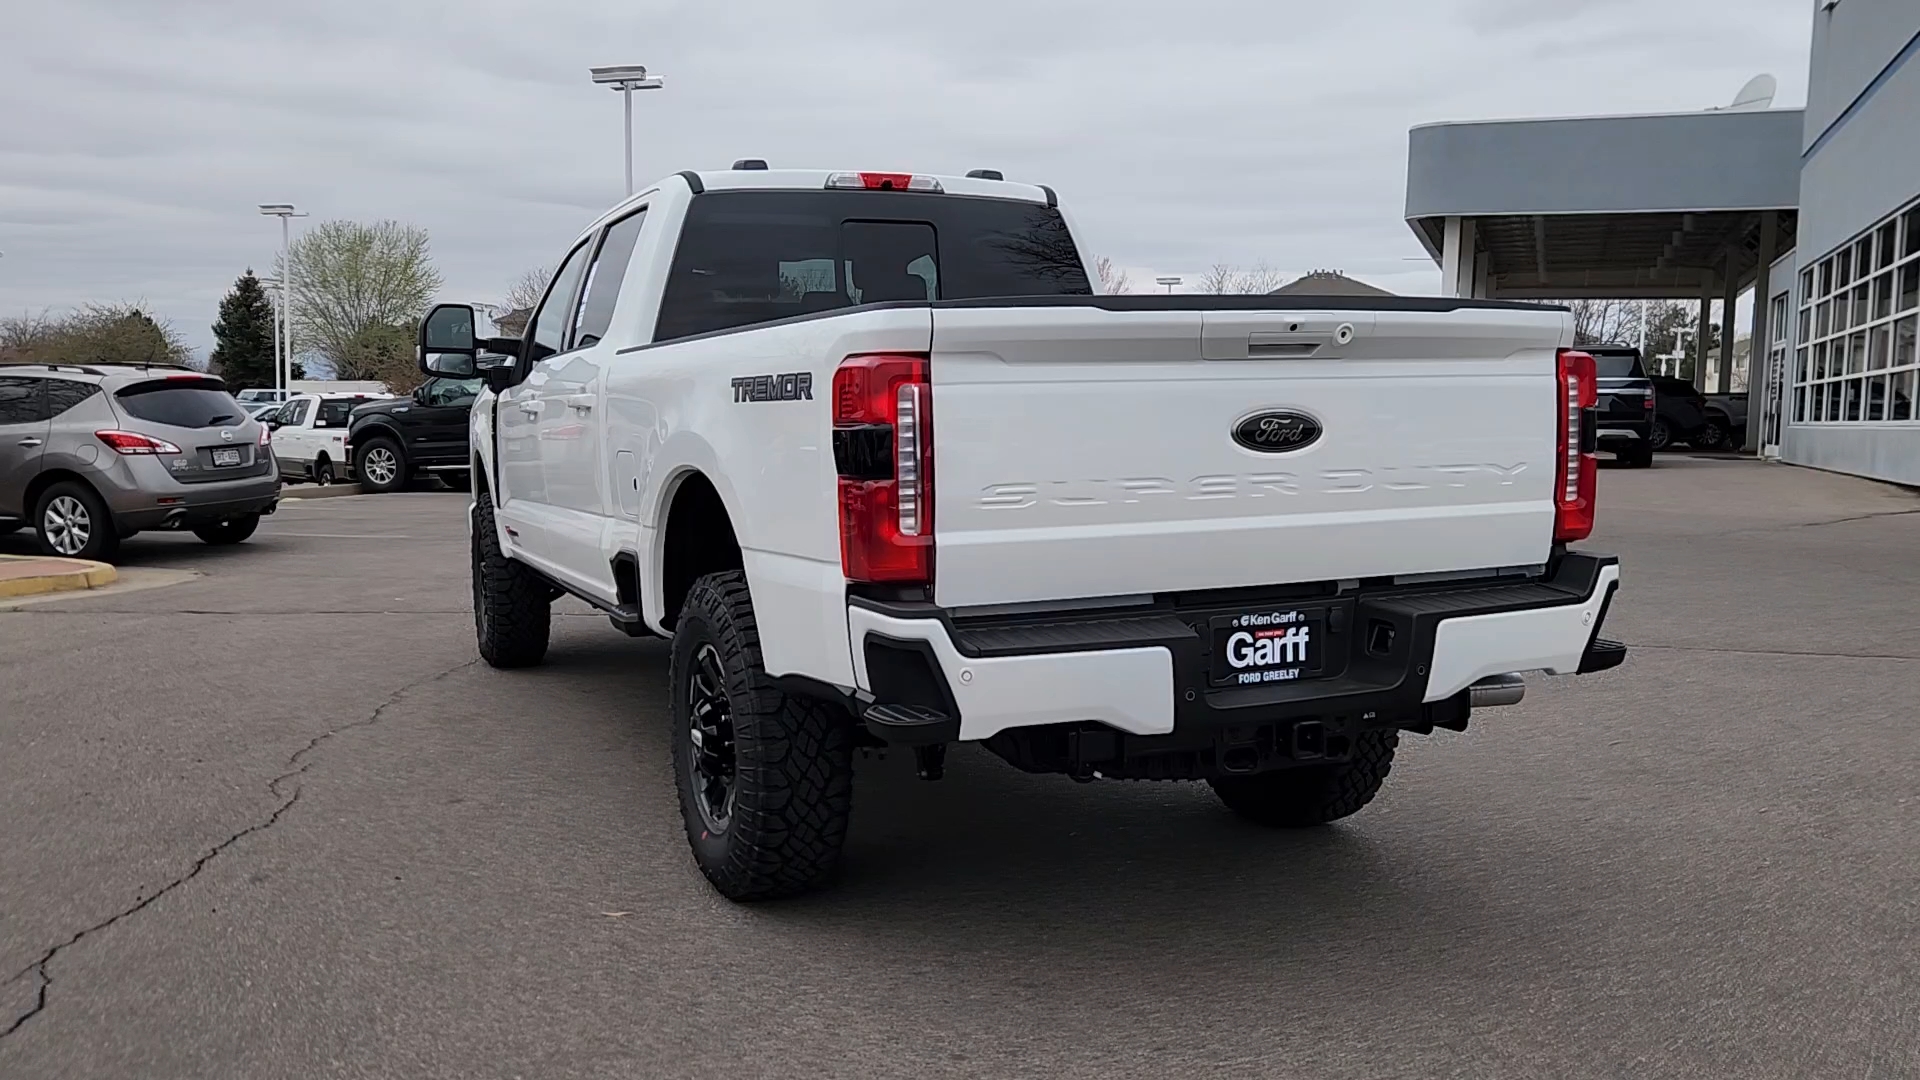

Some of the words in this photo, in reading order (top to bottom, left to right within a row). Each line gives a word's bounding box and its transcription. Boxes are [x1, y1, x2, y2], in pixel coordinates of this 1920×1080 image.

[731, 372, 813, 403] TREMOR
[1255, 417, 1304, 442] Ford
[979, 471, 1298, 510] SUPER
[1319, 462, 1528, 493] DUTY
[1250, 614, 1270, 626] Ken
[1271, 611, 1297, 624] Garff
[1226, 626, 1309, 668] Garff
[1239, 673, 1261, 684] FORD
[1263, 668, 1299, 682] GREELEY
